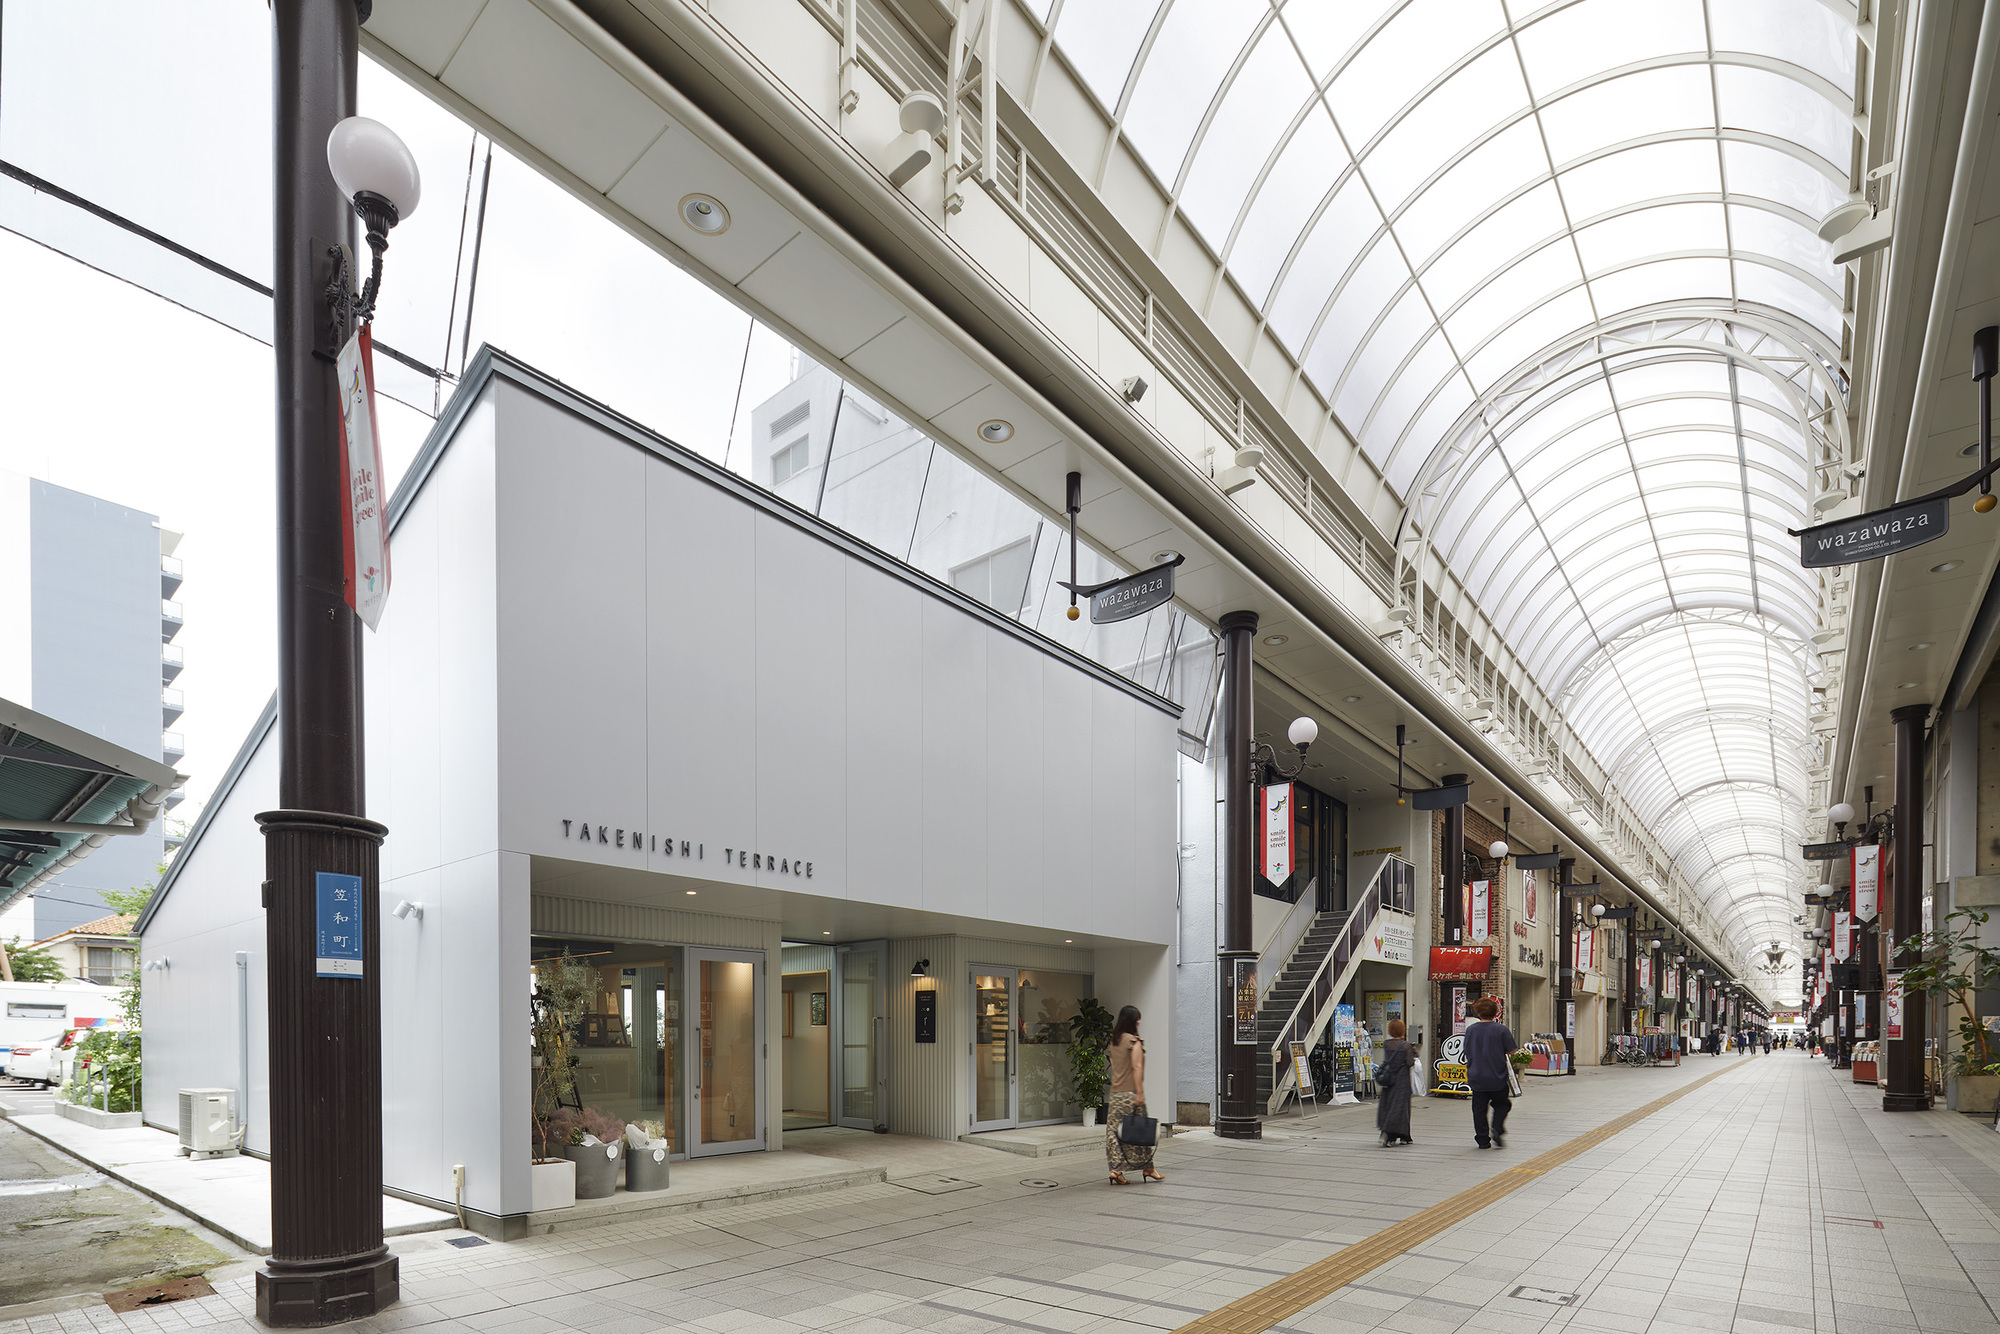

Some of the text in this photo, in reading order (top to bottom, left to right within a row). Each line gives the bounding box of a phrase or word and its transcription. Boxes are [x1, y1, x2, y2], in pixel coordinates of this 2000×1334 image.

[1818, 514, 1929, 550] wazawaza
[1100, 578, 1164, 608] wazawaza
[562, 819, 814, 878] TAKENISHI TERRACE
[333, 888, 349, 948] 笠和町
[1440, 947, 1483, 955] アーケード内
[1432, 972, 1488, 980] スケボー禁止です
[1441, 1071, 1466, 1080] OITA
